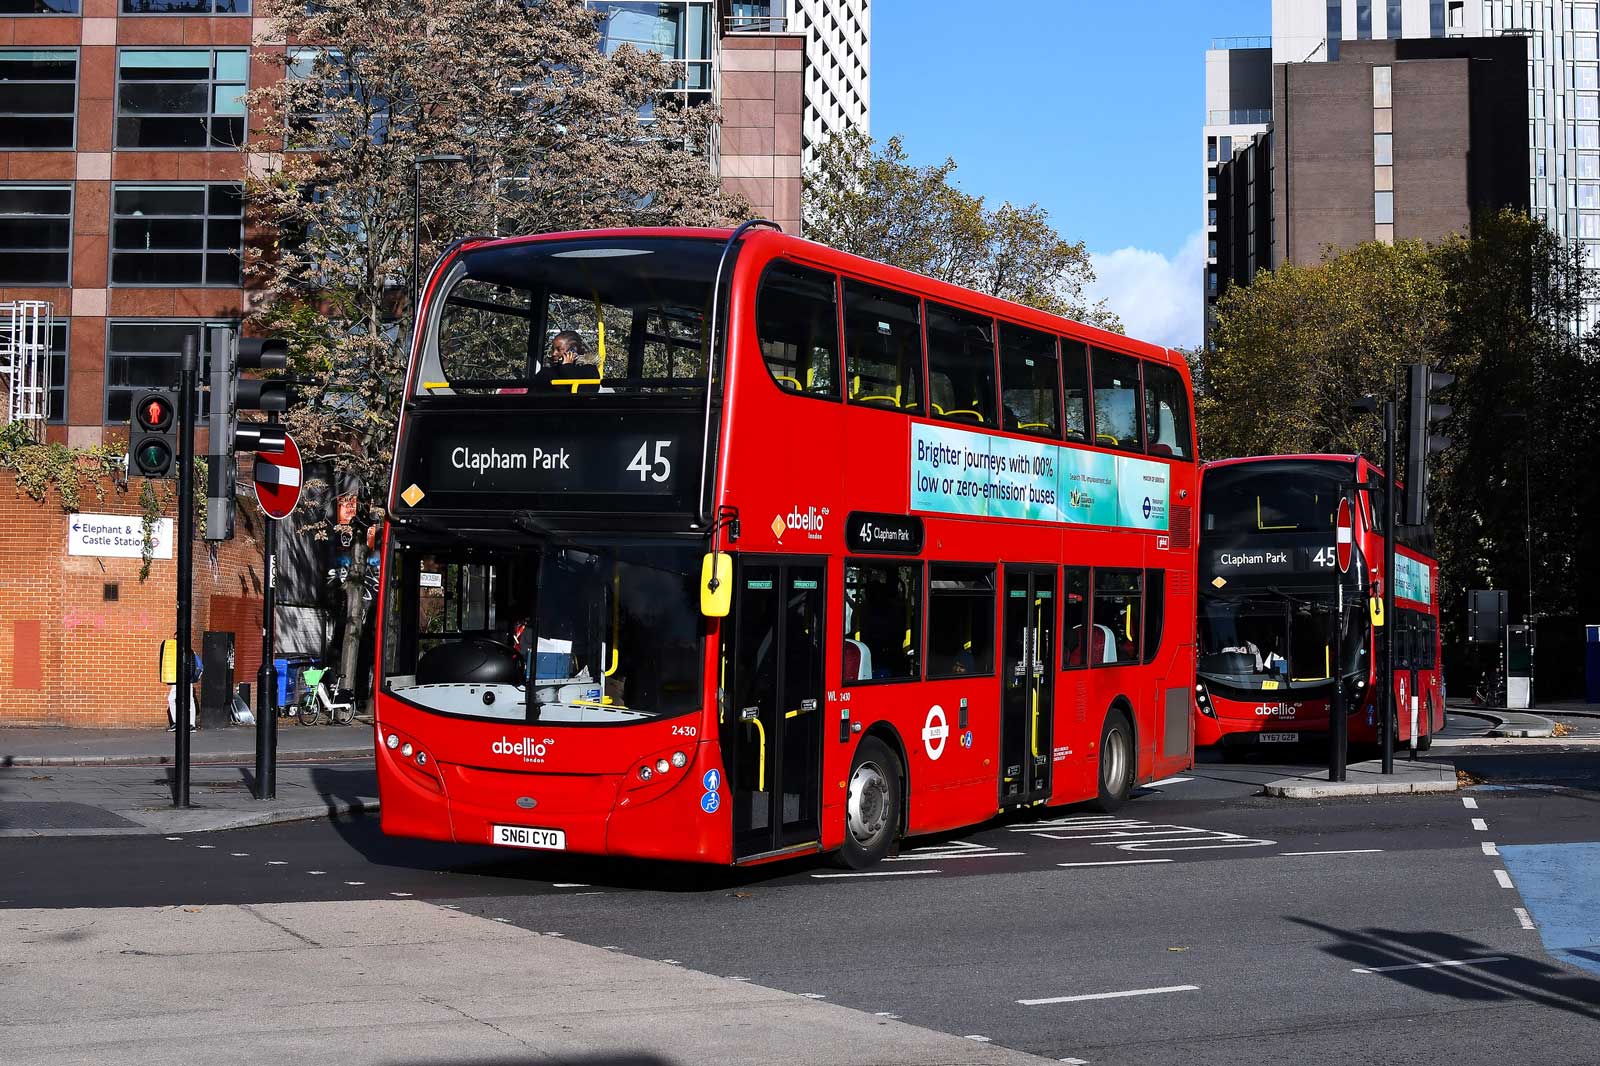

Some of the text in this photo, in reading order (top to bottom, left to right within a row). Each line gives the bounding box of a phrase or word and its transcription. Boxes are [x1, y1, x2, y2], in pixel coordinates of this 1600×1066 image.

[451, 440, 672, 482] Clapham Park 45
[917, 439, 1054, 478] Brighter journeys with 100%
[917, 470, 939, 494] low
[942, 478, 954, 495] or
[1029, 483, 1055, 505] buses
[786, 505, 824, 531] abellio
[82, 523, 132, 535] Elephant &
[859, 522, 910, 543] 45 Clapham Park
[82, 535, 111, 545] Castle
[1220, 546, 1336, 567] Clapham Park 45
[827, 690, 851, 702] WL 2430
[1255, 702, 1296, 716] abellio
[671, 725, 697, 737] 2430
[491, 736, 546, 757] abellio
[523, 756, 545, 764] london
[501, 828, 558, 846] SN61 CYO
